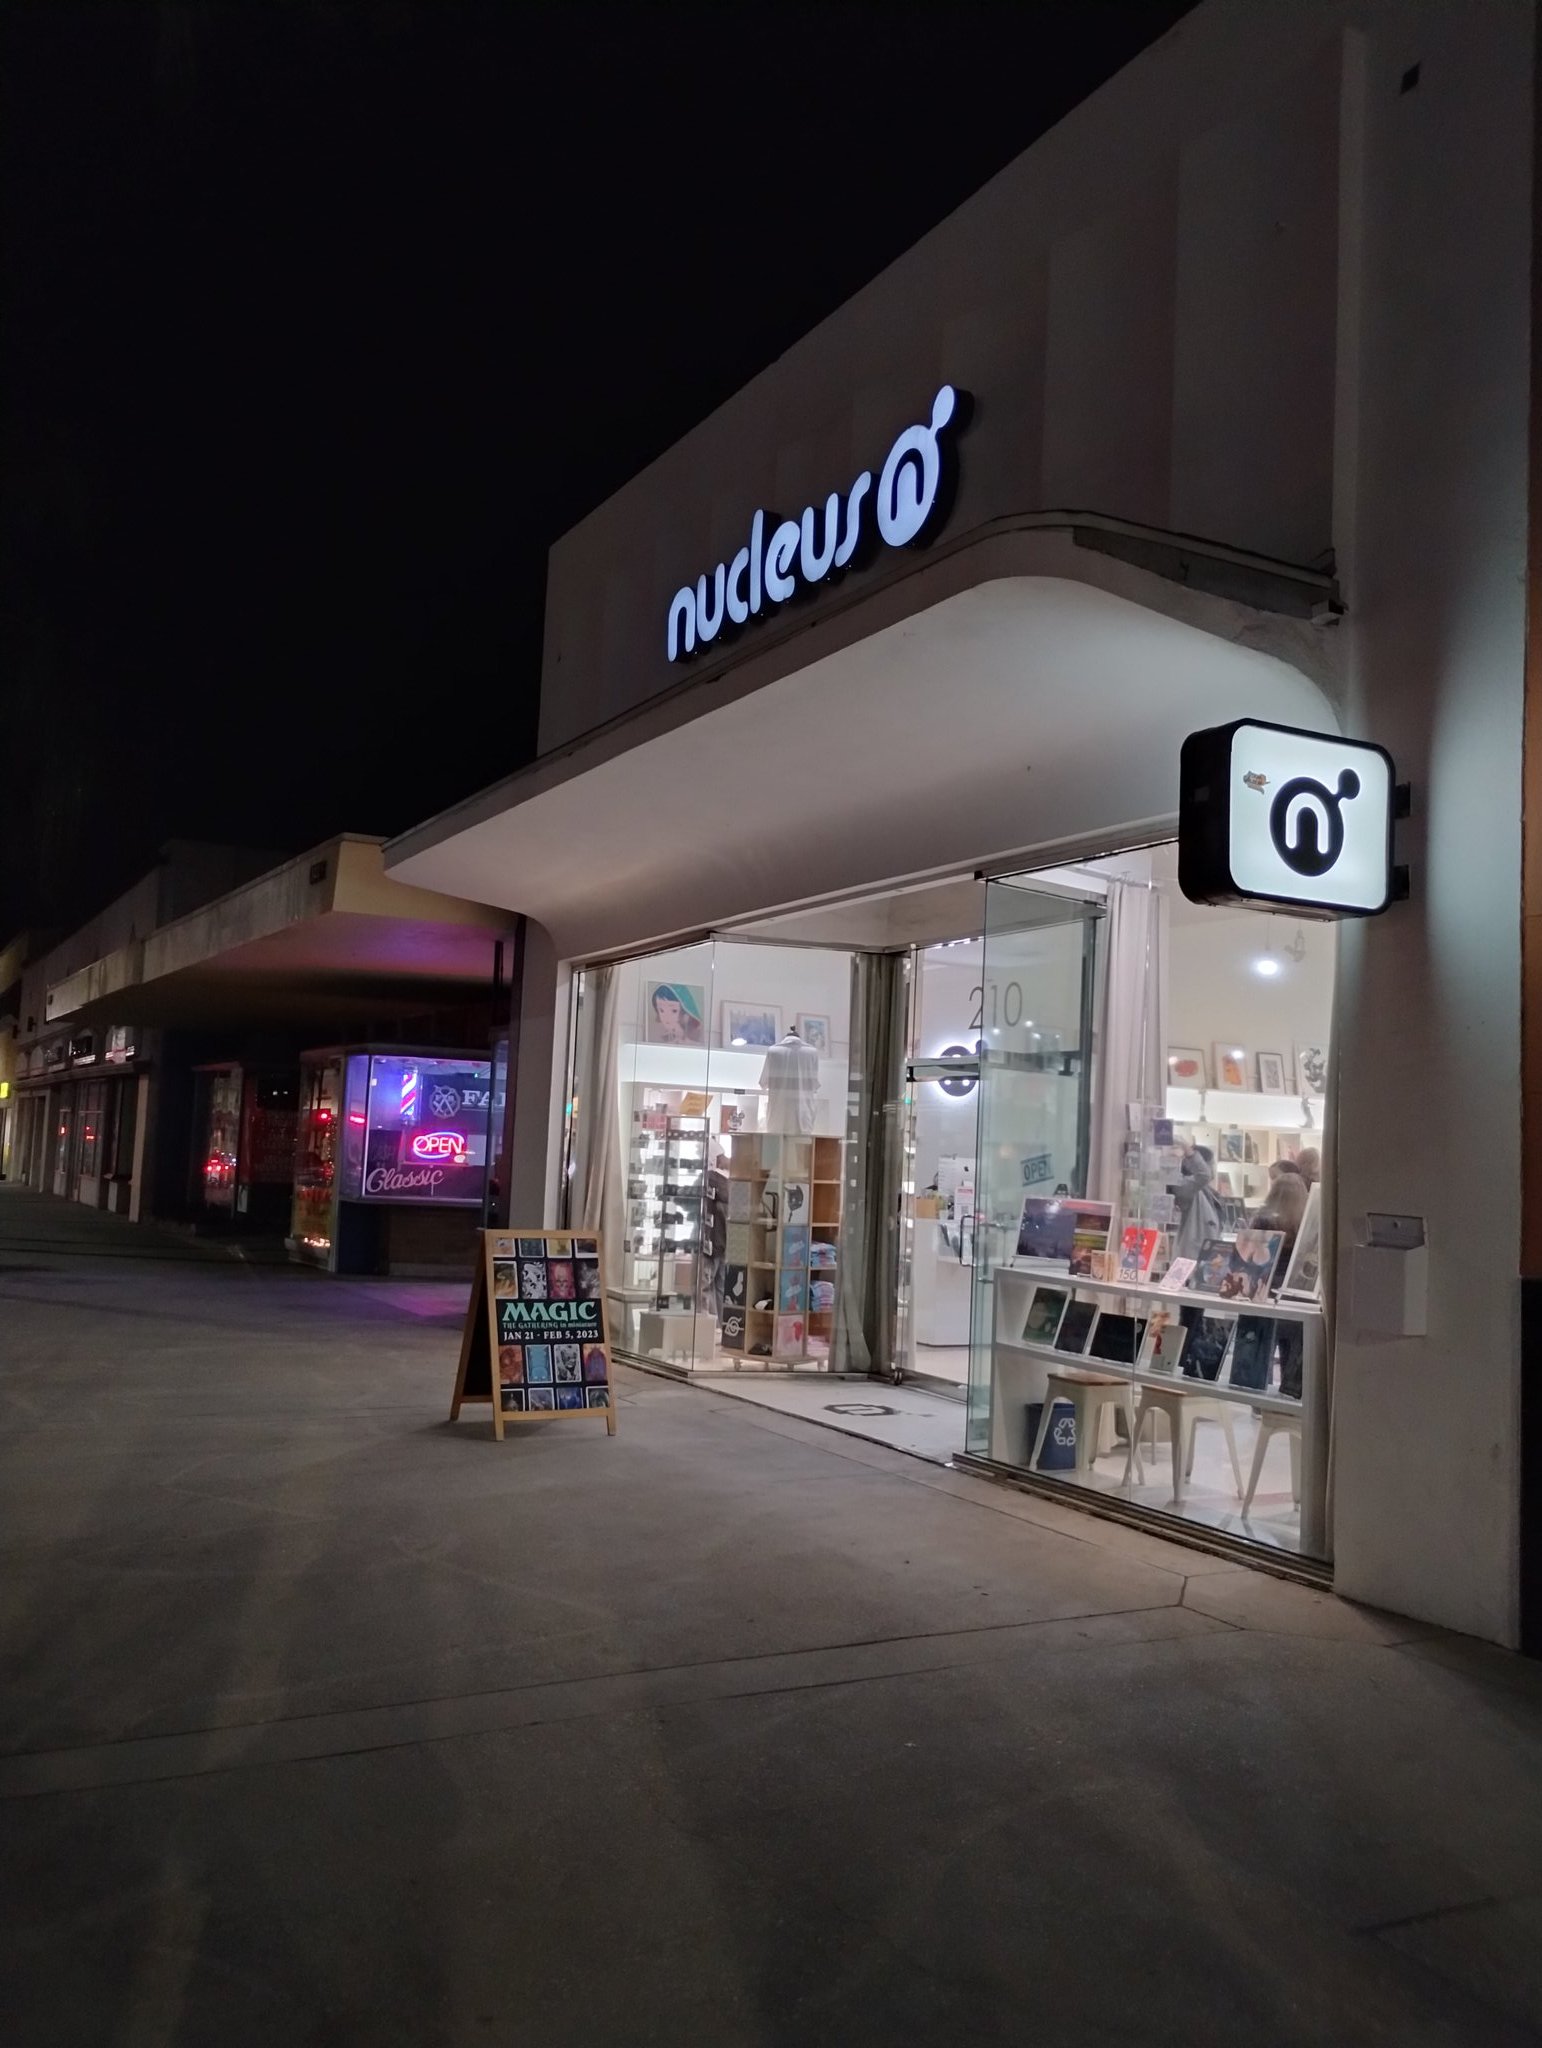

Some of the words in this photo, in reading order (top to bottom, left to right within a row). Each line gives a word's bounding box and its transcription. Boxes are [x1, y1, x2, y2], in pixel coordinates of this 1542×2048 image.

[667, 470, 872, 663] nucleus
[968, 981, 1023, 1030] 210
[414, 1135, 463, 1154] OPEN
[366, 1167, 445, 1193] Classic
[501, 1301, 597, 1321] MAGIC
[502, 1321, 516, 1329] THE
[517, 1321, 559, 1329] GATHERING
[503, 1331, 522, 1341] JAN
[524, 1331, 534, 1340] 21
[543, 1330, 563, 1340] FEB
[564, 1330, 574, 1340] 5,
[576, 1330, 599, 1338] 2023
